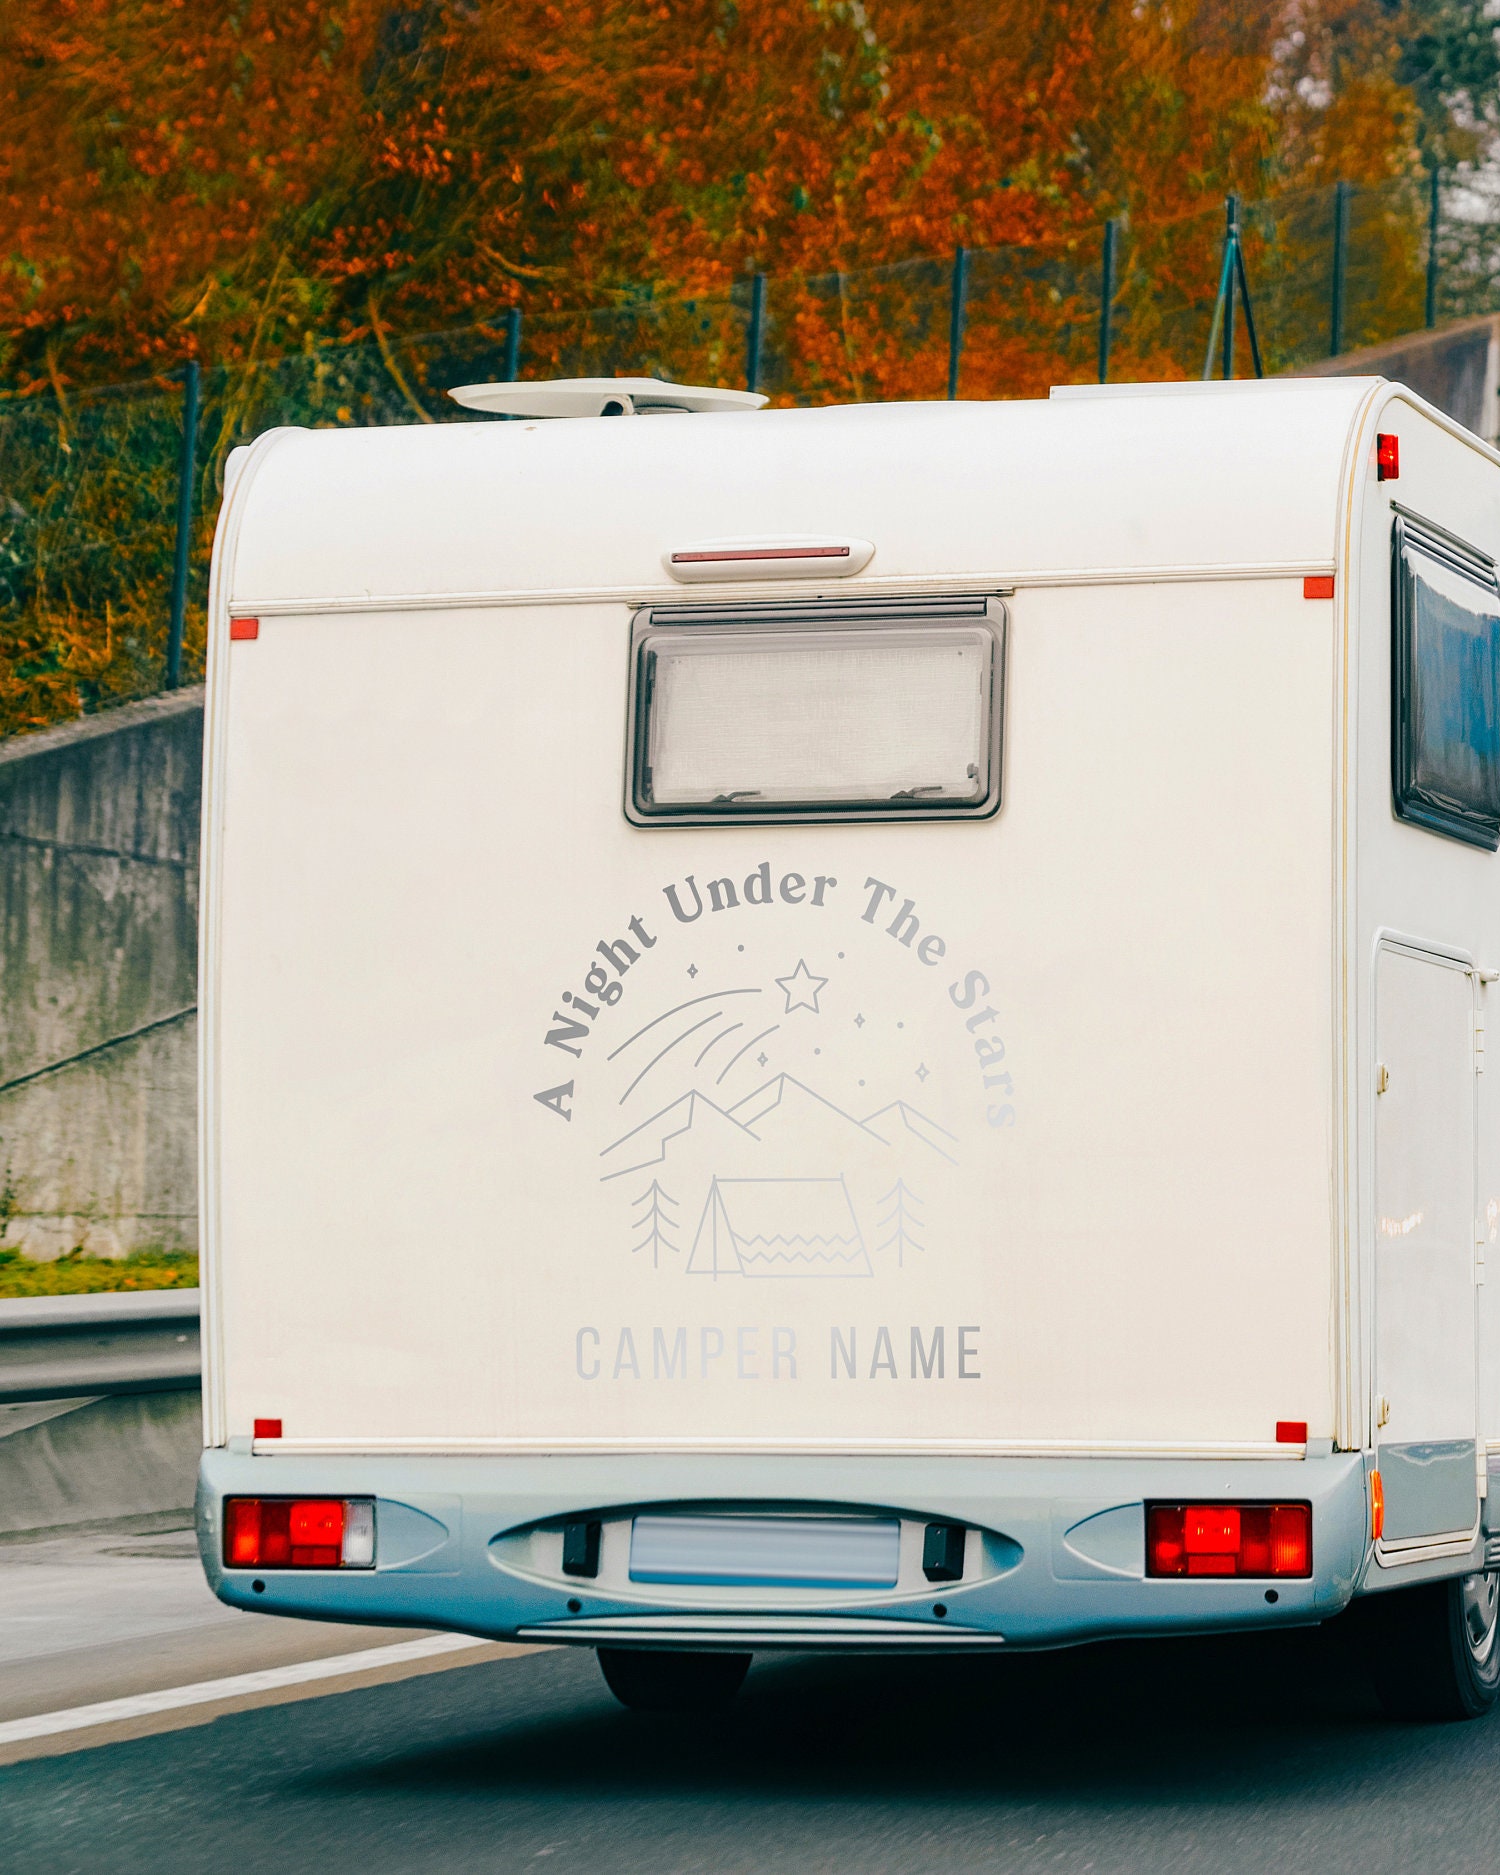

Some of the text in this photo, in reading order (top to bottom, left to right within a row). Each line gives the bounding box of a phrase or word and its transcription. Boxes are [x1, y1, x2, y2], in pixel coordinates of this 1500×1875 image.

[533, 862, 1017, 1130] A Night Under The Stars
[575, 1326, 982, 1380] CAMPER NAME
